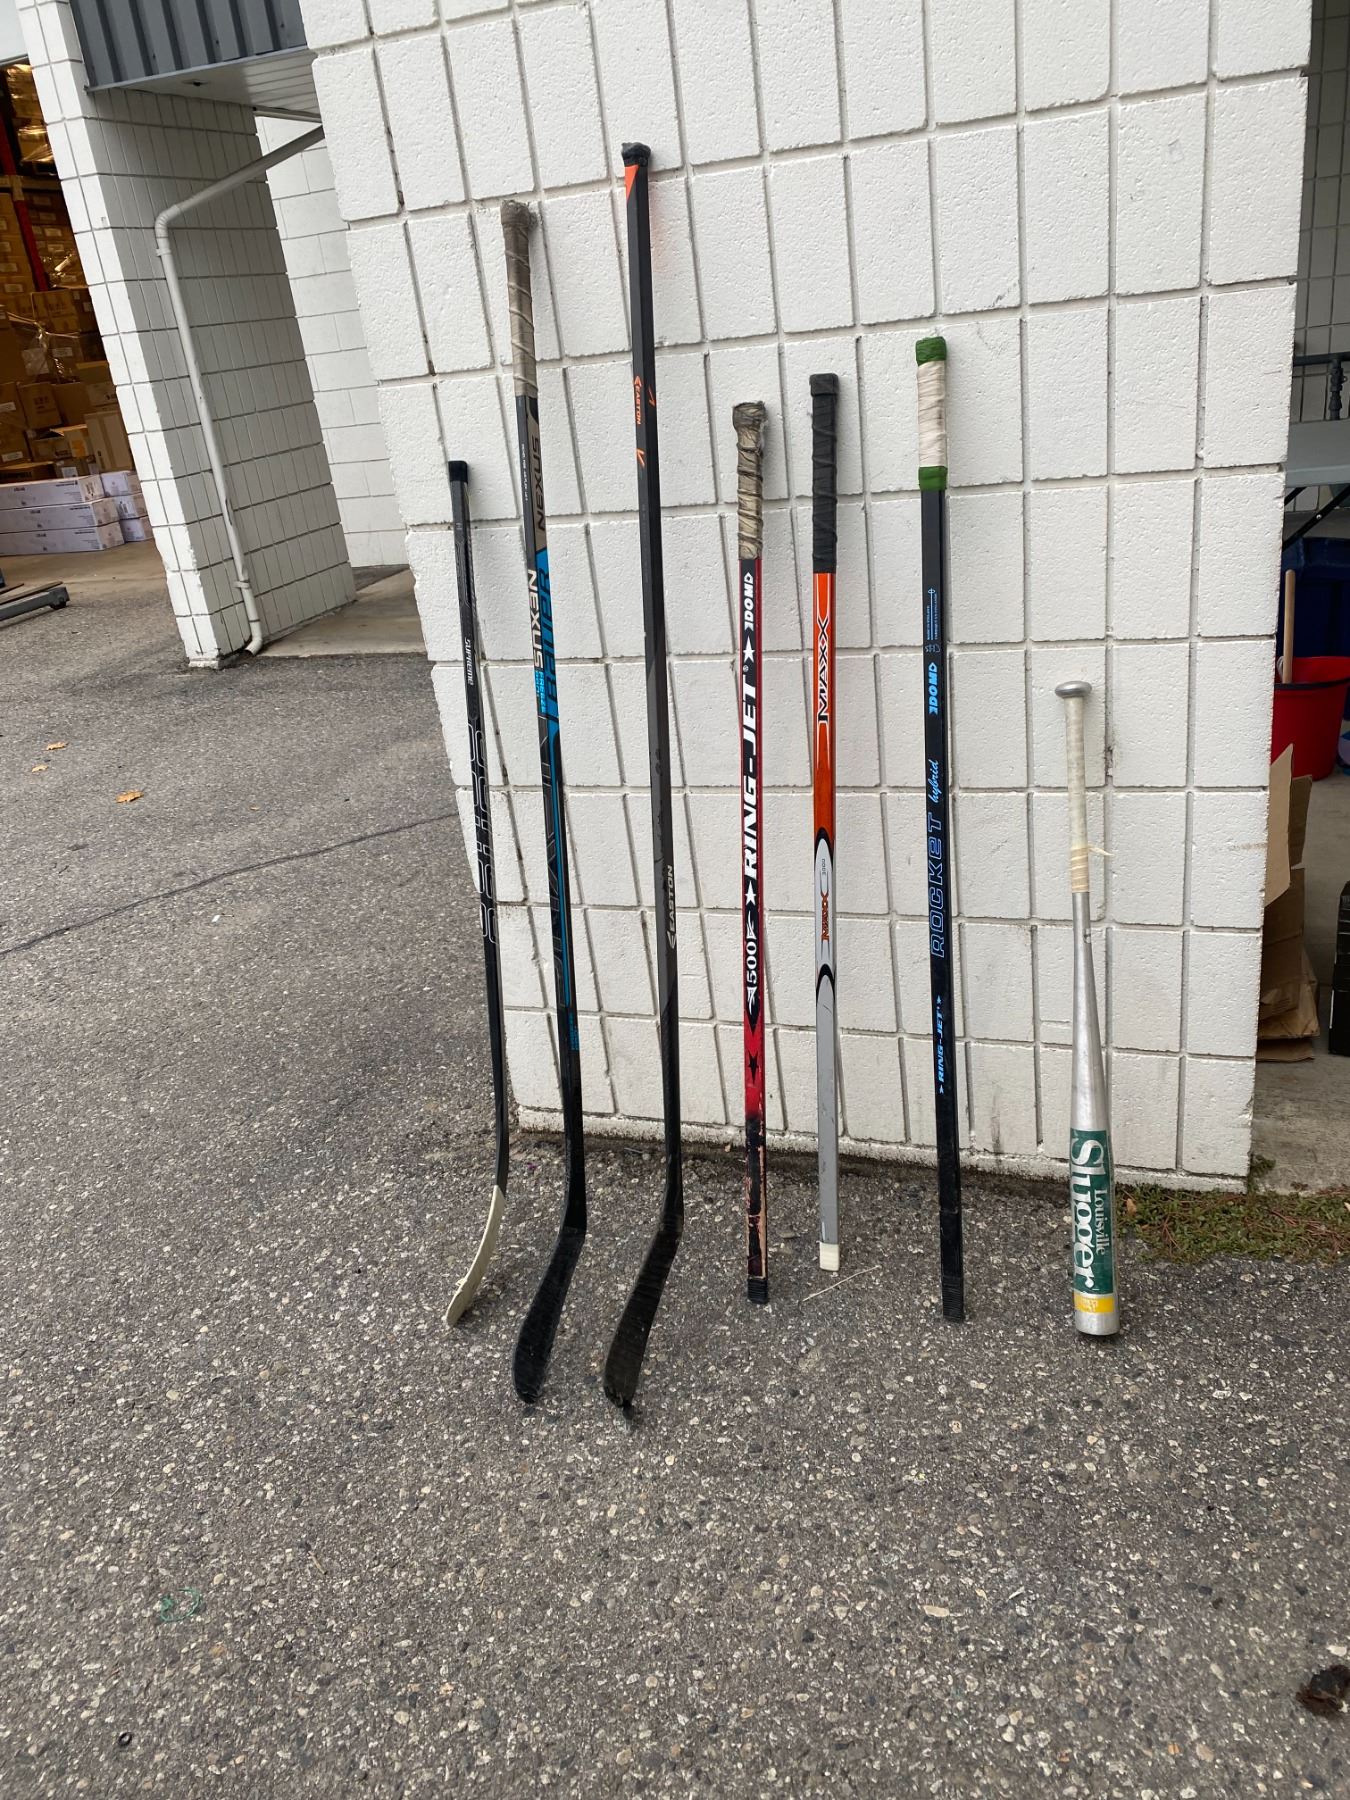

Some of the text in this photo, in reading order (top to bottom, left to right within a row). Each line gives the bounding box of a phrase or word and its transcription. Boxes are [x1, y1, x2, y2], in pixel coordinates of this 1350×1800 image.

[635, 385, 643, 425] EASTON
[531, 435, 546, 532] NEXUS
[528, 569, 544, 669] NEXUS
[464, 637, 475, 686] SUPREME
[817, 616, 829, 723] MAXX
[927, 758, 942, 803] hybrid
[667, 864, 676, 933] EASTON
[927, 812, 945, 958] ROCKET
[746, 941, 757, 984] 500
[1070, 1137, 1106, 1288] Slugger
[1094, 1188, 1110, 1256] Louisville
